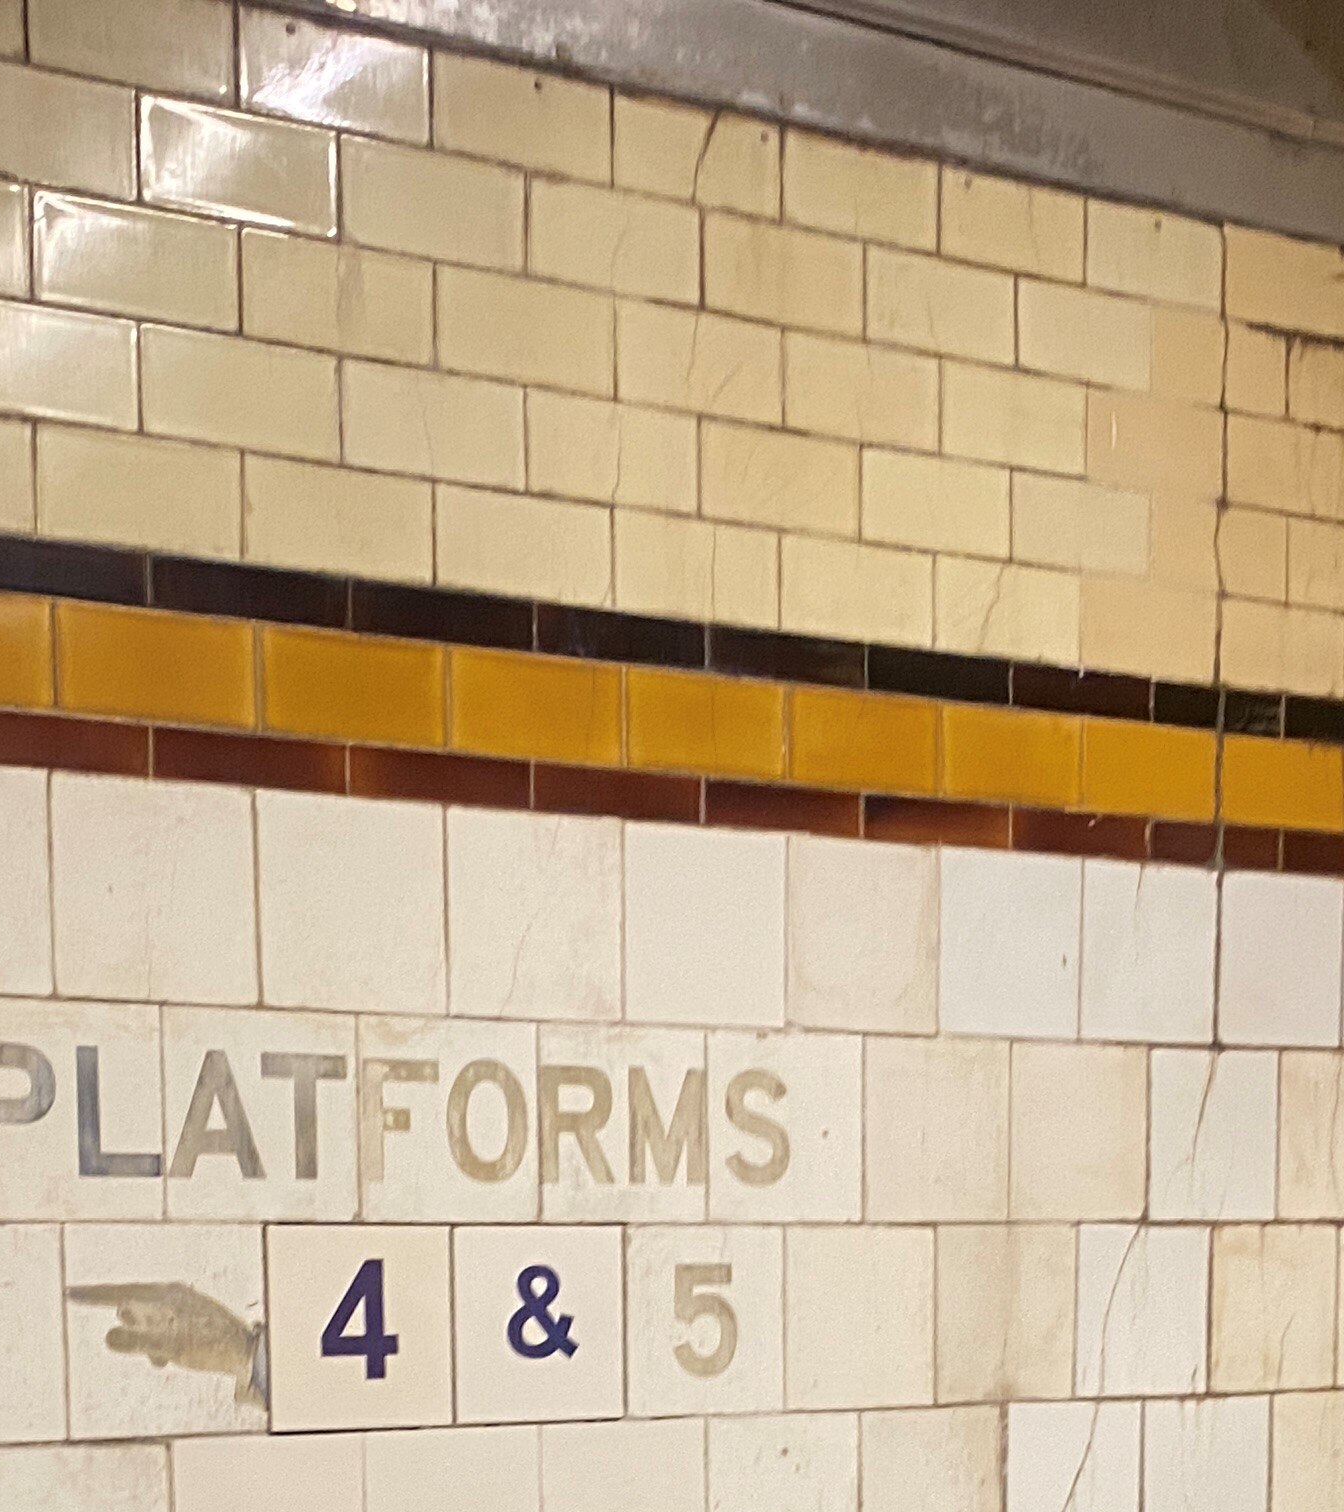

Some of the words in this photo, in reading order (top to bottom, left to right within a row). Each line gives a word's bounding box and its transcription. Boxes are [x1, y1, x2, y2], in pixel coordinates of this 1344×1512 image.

[321, 1259, 399, 1379] 4
[506, 1265, 579, 1359] &
[672, 1263, 738, 1377] 5
